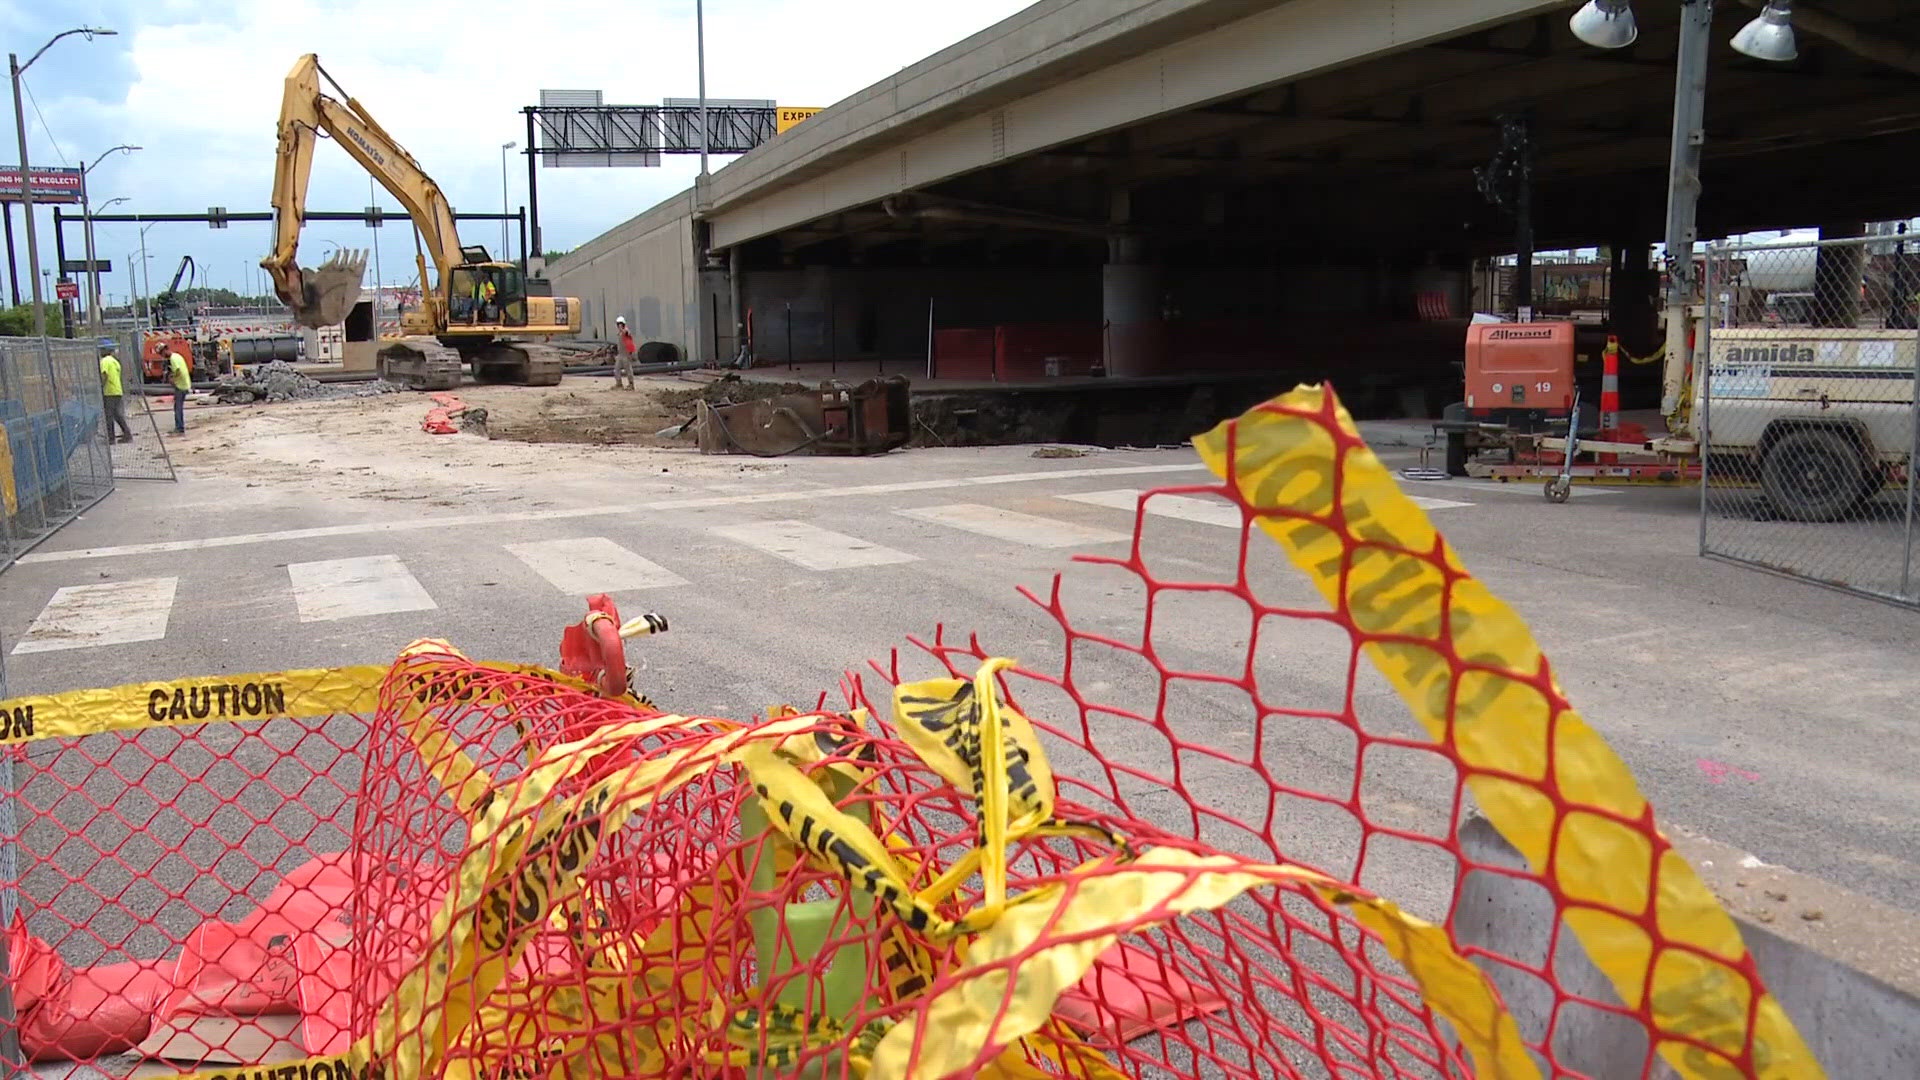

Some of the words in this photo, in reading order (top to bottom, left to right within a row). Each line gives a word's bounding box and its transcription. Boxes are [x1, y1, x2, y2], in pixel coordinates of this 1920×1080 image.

[783, 111, 816, 121] EXPR
[347, 127, 385, 166] KOMATSU
[39, 177, 79, 185] NEGLECT?
[1488, 329, 1552, 340] Allmand
[1726, 344, 1815, 362] amida
[1535, 382, 1551, 392] 19
[147, 683, 285, 721] CAUTION
